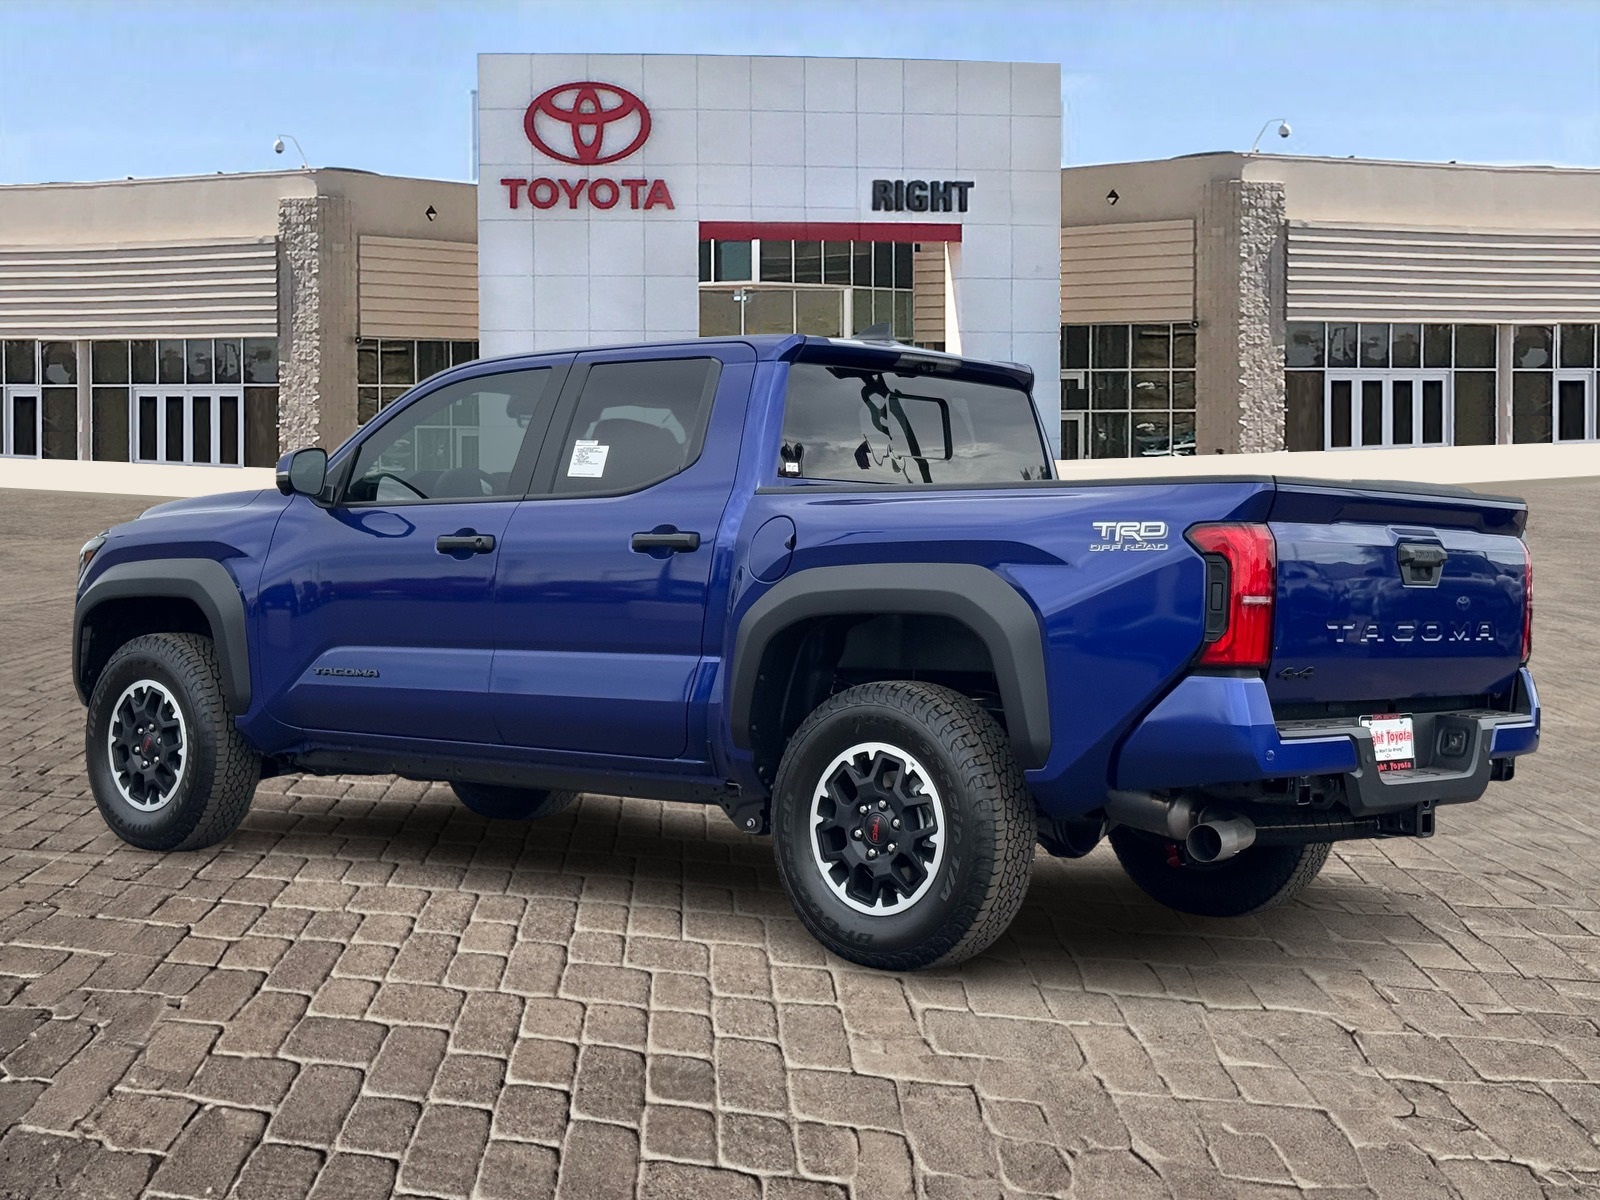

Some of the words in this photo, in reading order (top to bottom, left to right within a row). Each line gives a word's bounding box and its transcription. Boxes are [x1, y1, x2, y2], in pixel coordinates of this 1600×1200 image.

[500, 177, 675, 210] TOYOTA
[872, 179, 975, 212] RIGHT
[1092, 521, 1169, 542] TRD
[1089, 543, 1121, 552] OFF
[1123, 543, 1169, 552] ROAD
[1326, 621, 1494, 643] TACOMA
[313, 668, 380, 678] TACOMA
[1372, 731, 1385, 747] ght
[1386, 729, 1412, 745] Toyota
[1377, 763, 1388, 772] ght
[1389, 761, 1412, 770] Toyota
